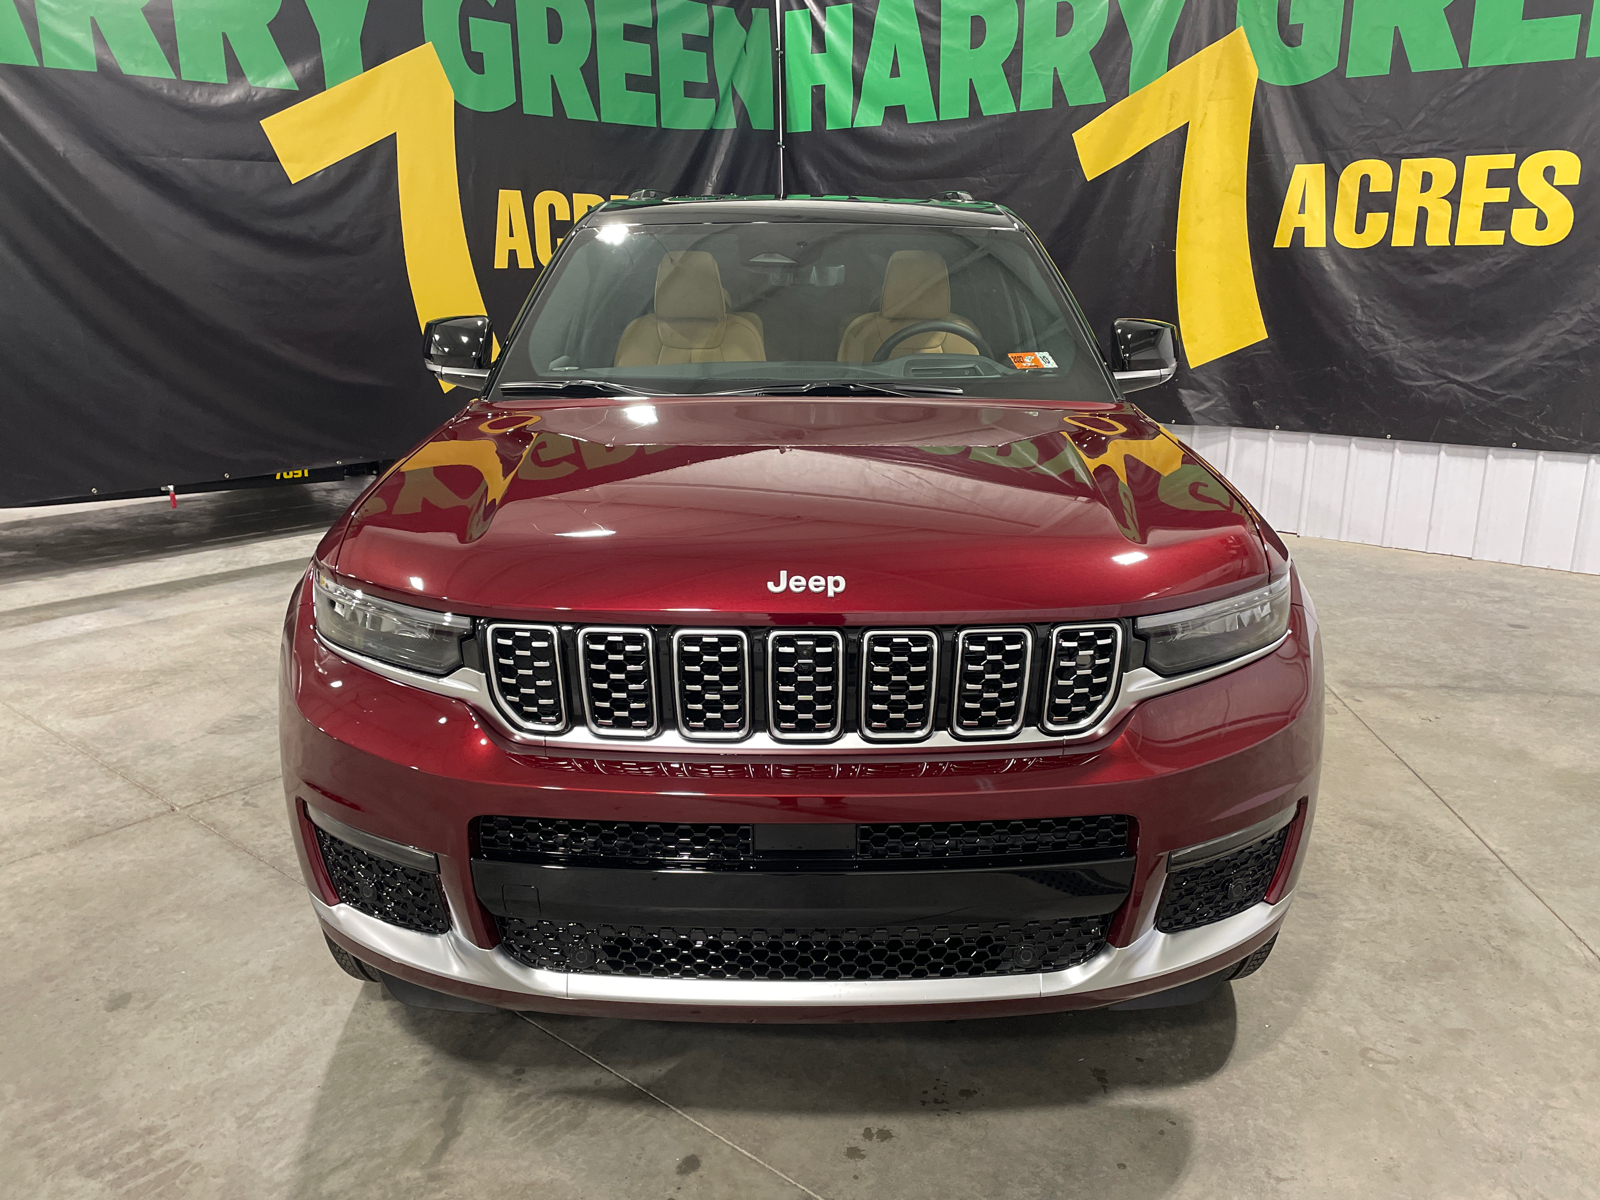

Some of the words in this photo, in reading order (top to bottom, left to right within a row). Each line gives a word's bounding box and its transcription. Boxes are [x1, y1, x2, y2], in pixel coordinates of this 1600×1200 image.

[423, 0, 774, 131] GREEN
[785, 0, 1186, 133] HARRY
[260, 42, 501, 394] 7
[1072, 26, 1268, 369] 7
[1273, 150, 1582, 249] ACRES
[766, 570, 846, 598] Jeep
